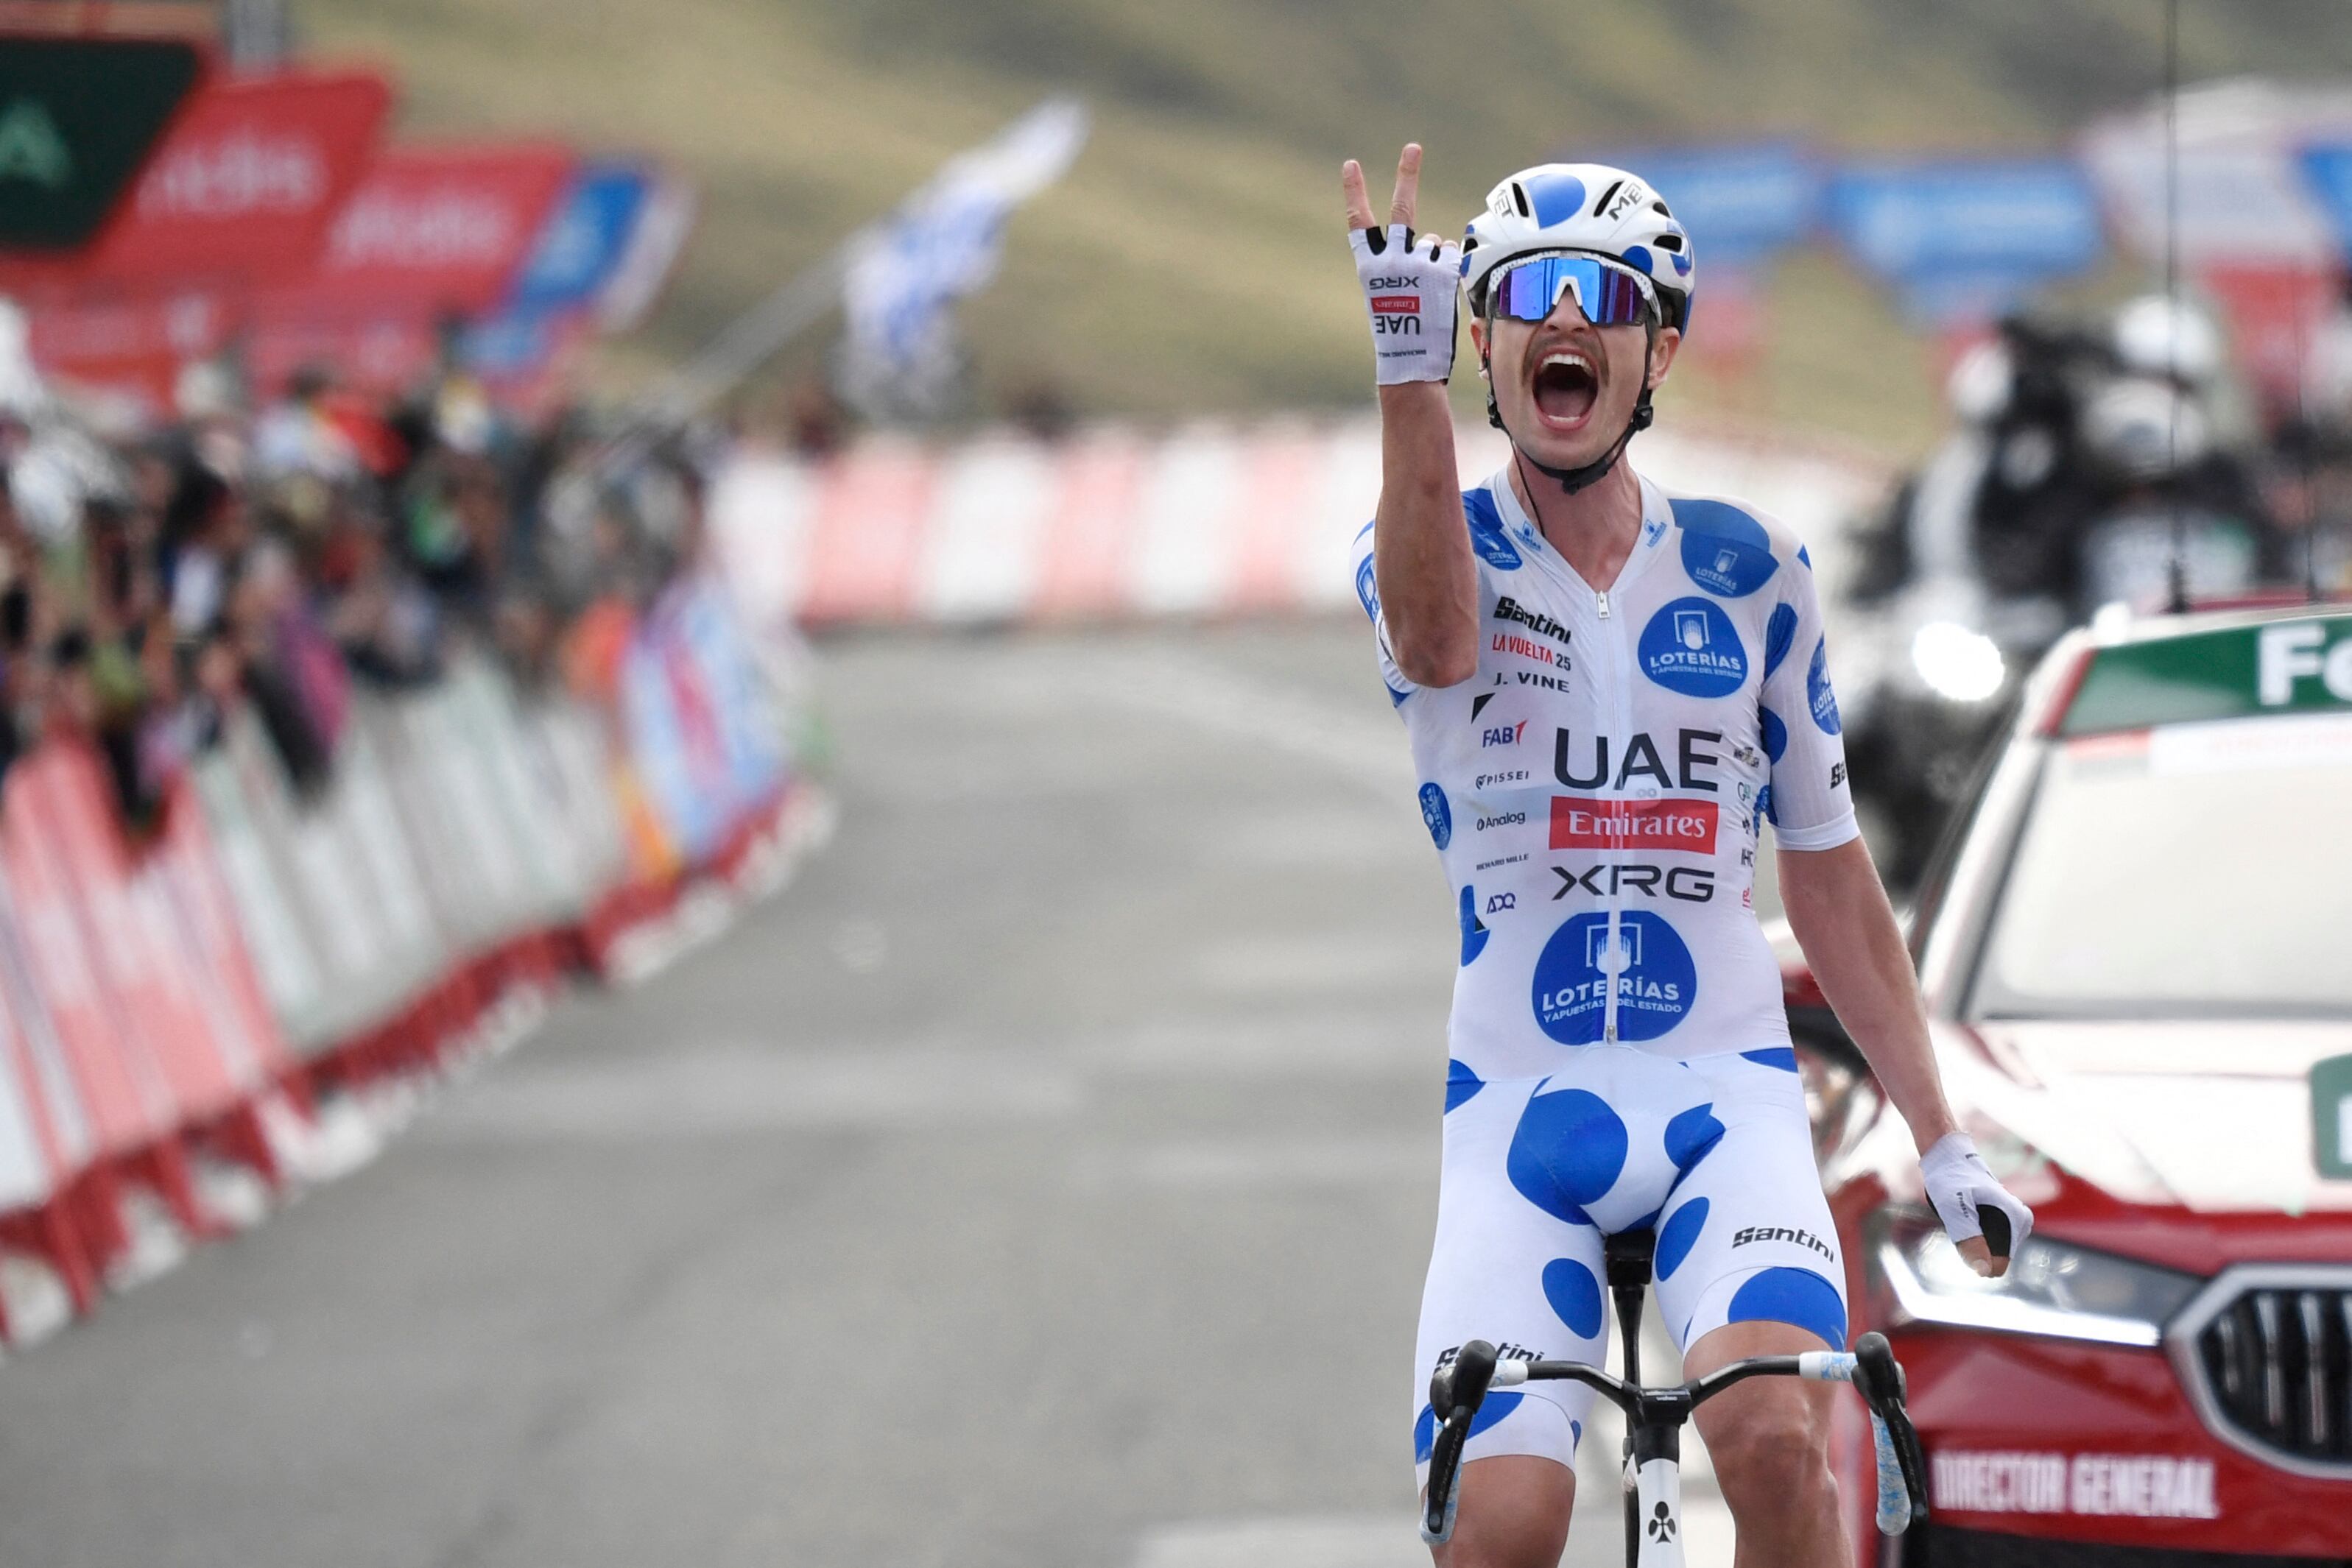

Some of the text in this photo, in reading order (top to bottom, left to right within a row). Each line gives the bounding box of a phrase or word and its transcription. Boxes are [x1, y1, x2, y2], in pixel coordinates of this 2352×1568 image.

[1369, 276, 1420, 290] XRG
[1373, 315, 1420, 336] UAE
[1493, 596, 1572, 645] Santini
[1492, 633, 1571, 672] LA VUELTA 25
[1493, 671, 1571, 694] J. VINE
[1554, 727, 1723, 793] UAE
[1487, 770, 1529, 786] PISSEI
[1485, 811, 1526, 829] Analog
[1568, 810, 1707, 839] Emirates
[1550, 864, 1716, 903] XRG
[1637, 1000, 1683, 1014] ESTADO
[1731, 1226, 1835, 1264] Santini
